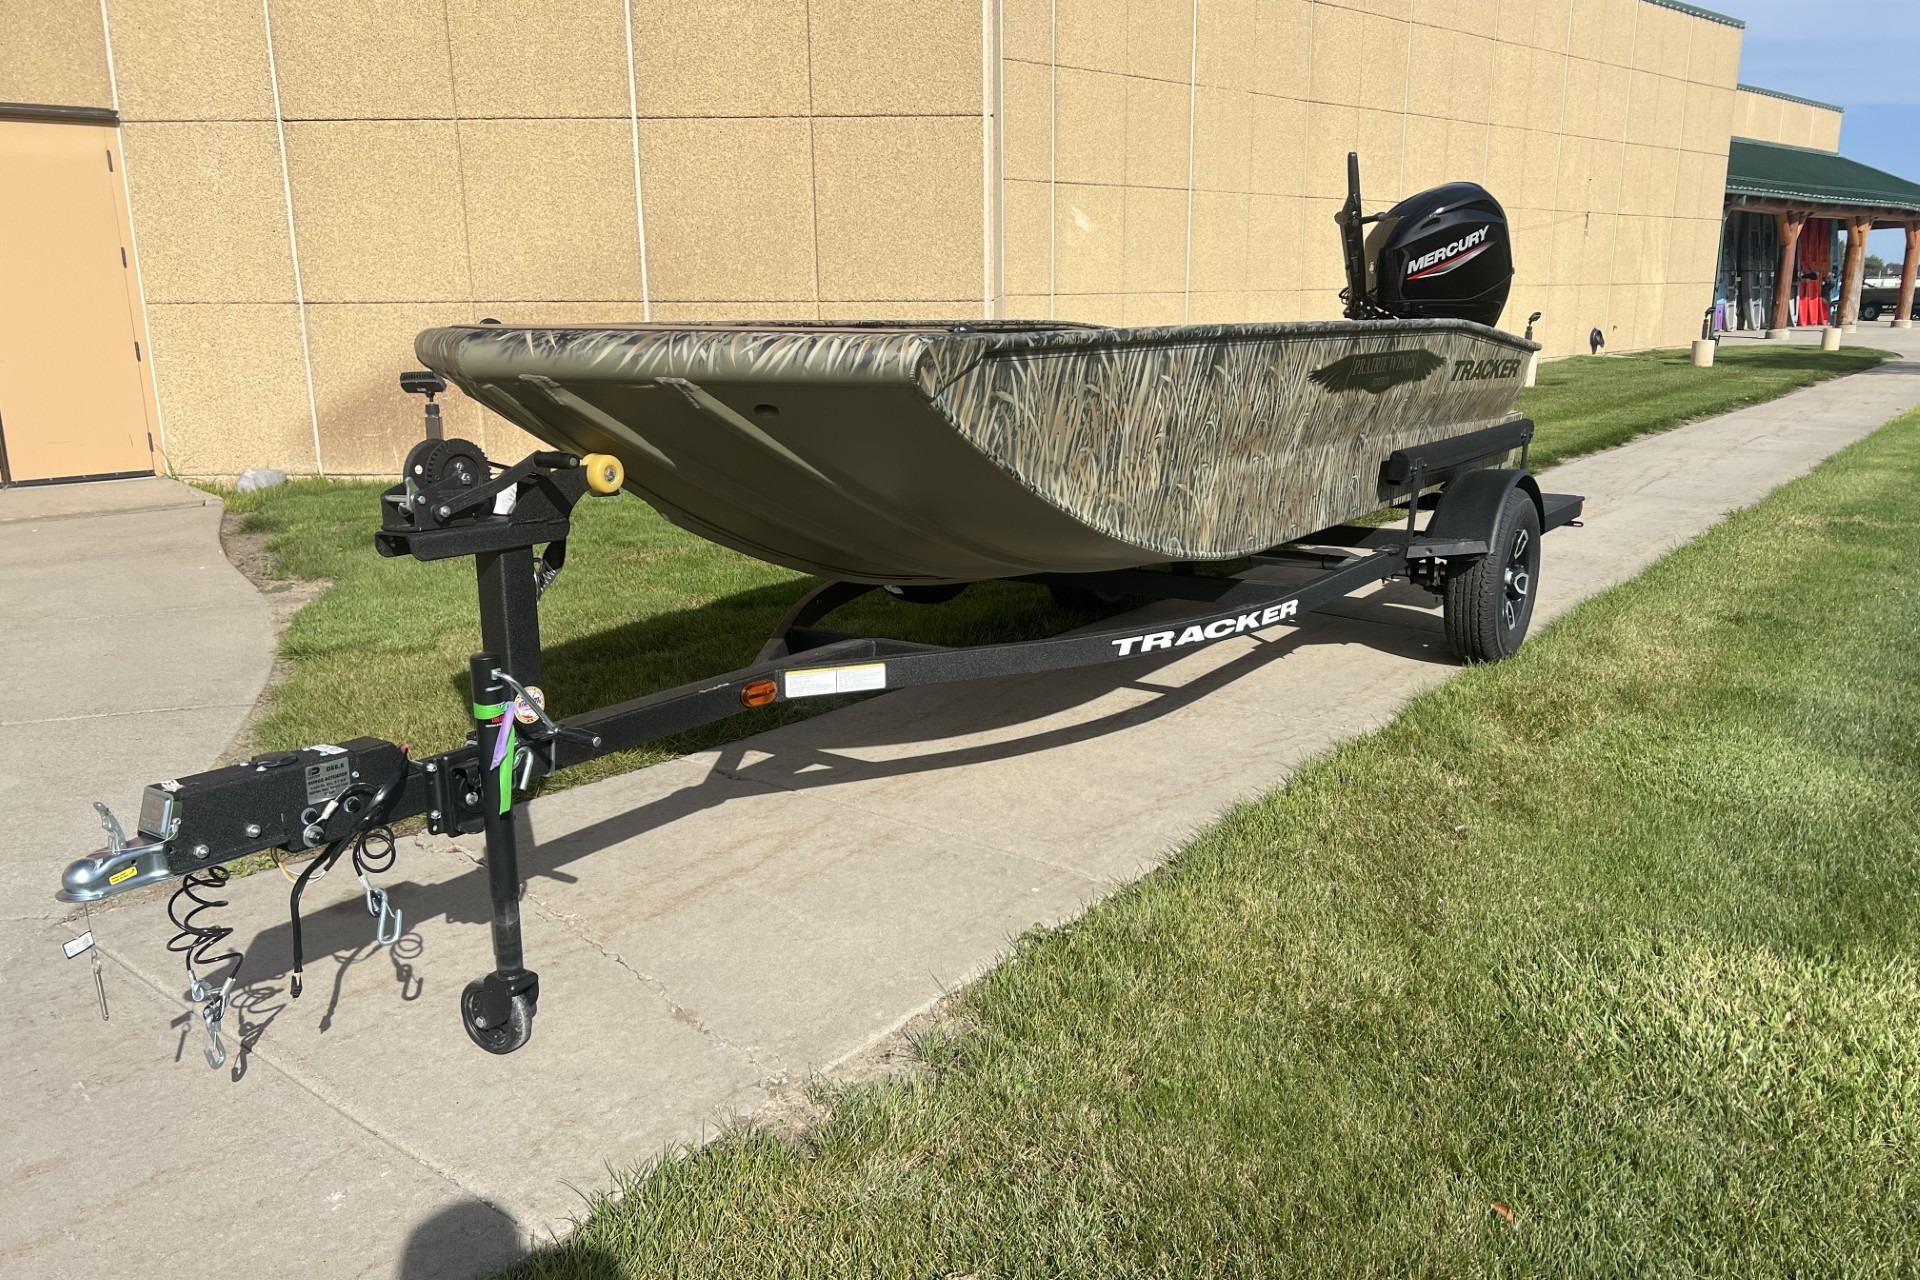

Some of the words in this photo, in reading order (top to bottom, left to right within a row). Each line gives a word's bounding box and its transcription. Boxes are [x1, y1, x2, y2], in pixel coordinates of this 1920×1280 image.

[1407, 224, 1490, 274] MERCURY
[1451, 358, 1521, 381] TRACKER
[1111, 599, 1299, 657] TRACKER
